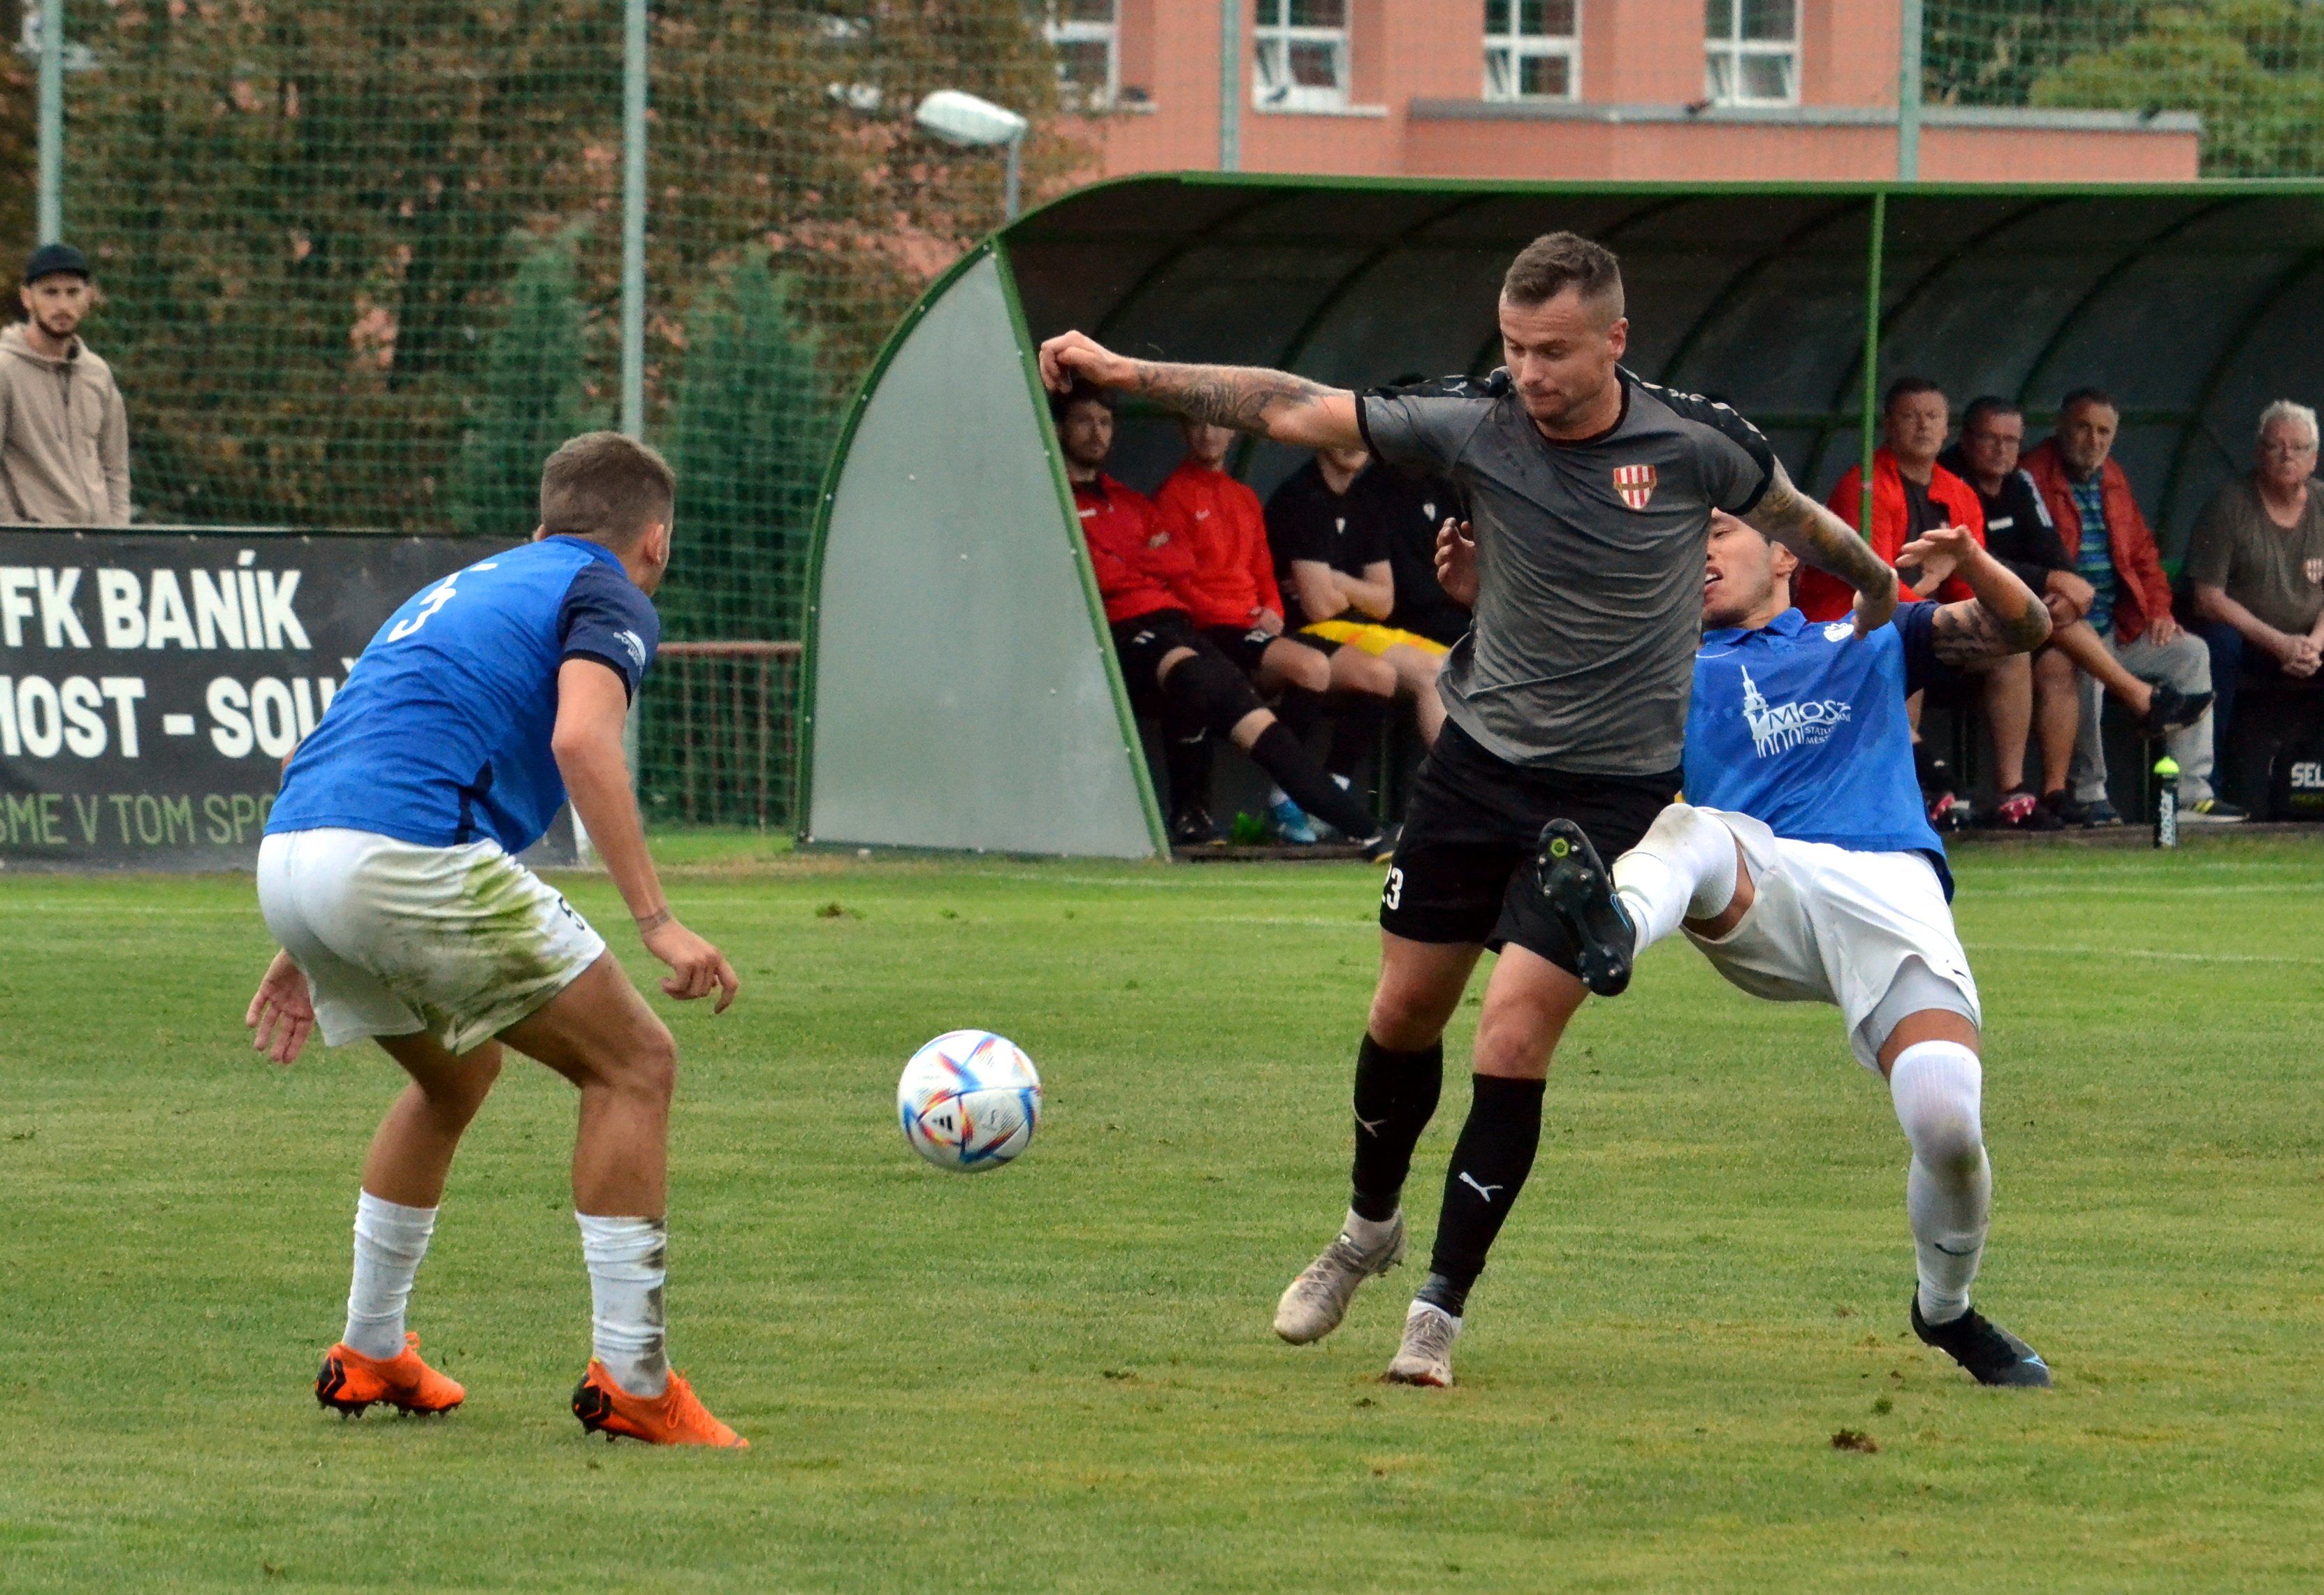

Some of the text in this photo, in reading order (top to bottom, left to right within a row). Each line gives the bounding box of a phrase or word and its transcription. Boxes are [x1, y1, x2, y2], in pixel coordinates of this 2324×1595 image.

[0, 549, 312, 650] FK BANÍK
[205, 657, 359, 759] SOU
[0, 793, 68, 844] ME
[72, 793, 99, 845] V
[108, 793, 196, 845] TOM
